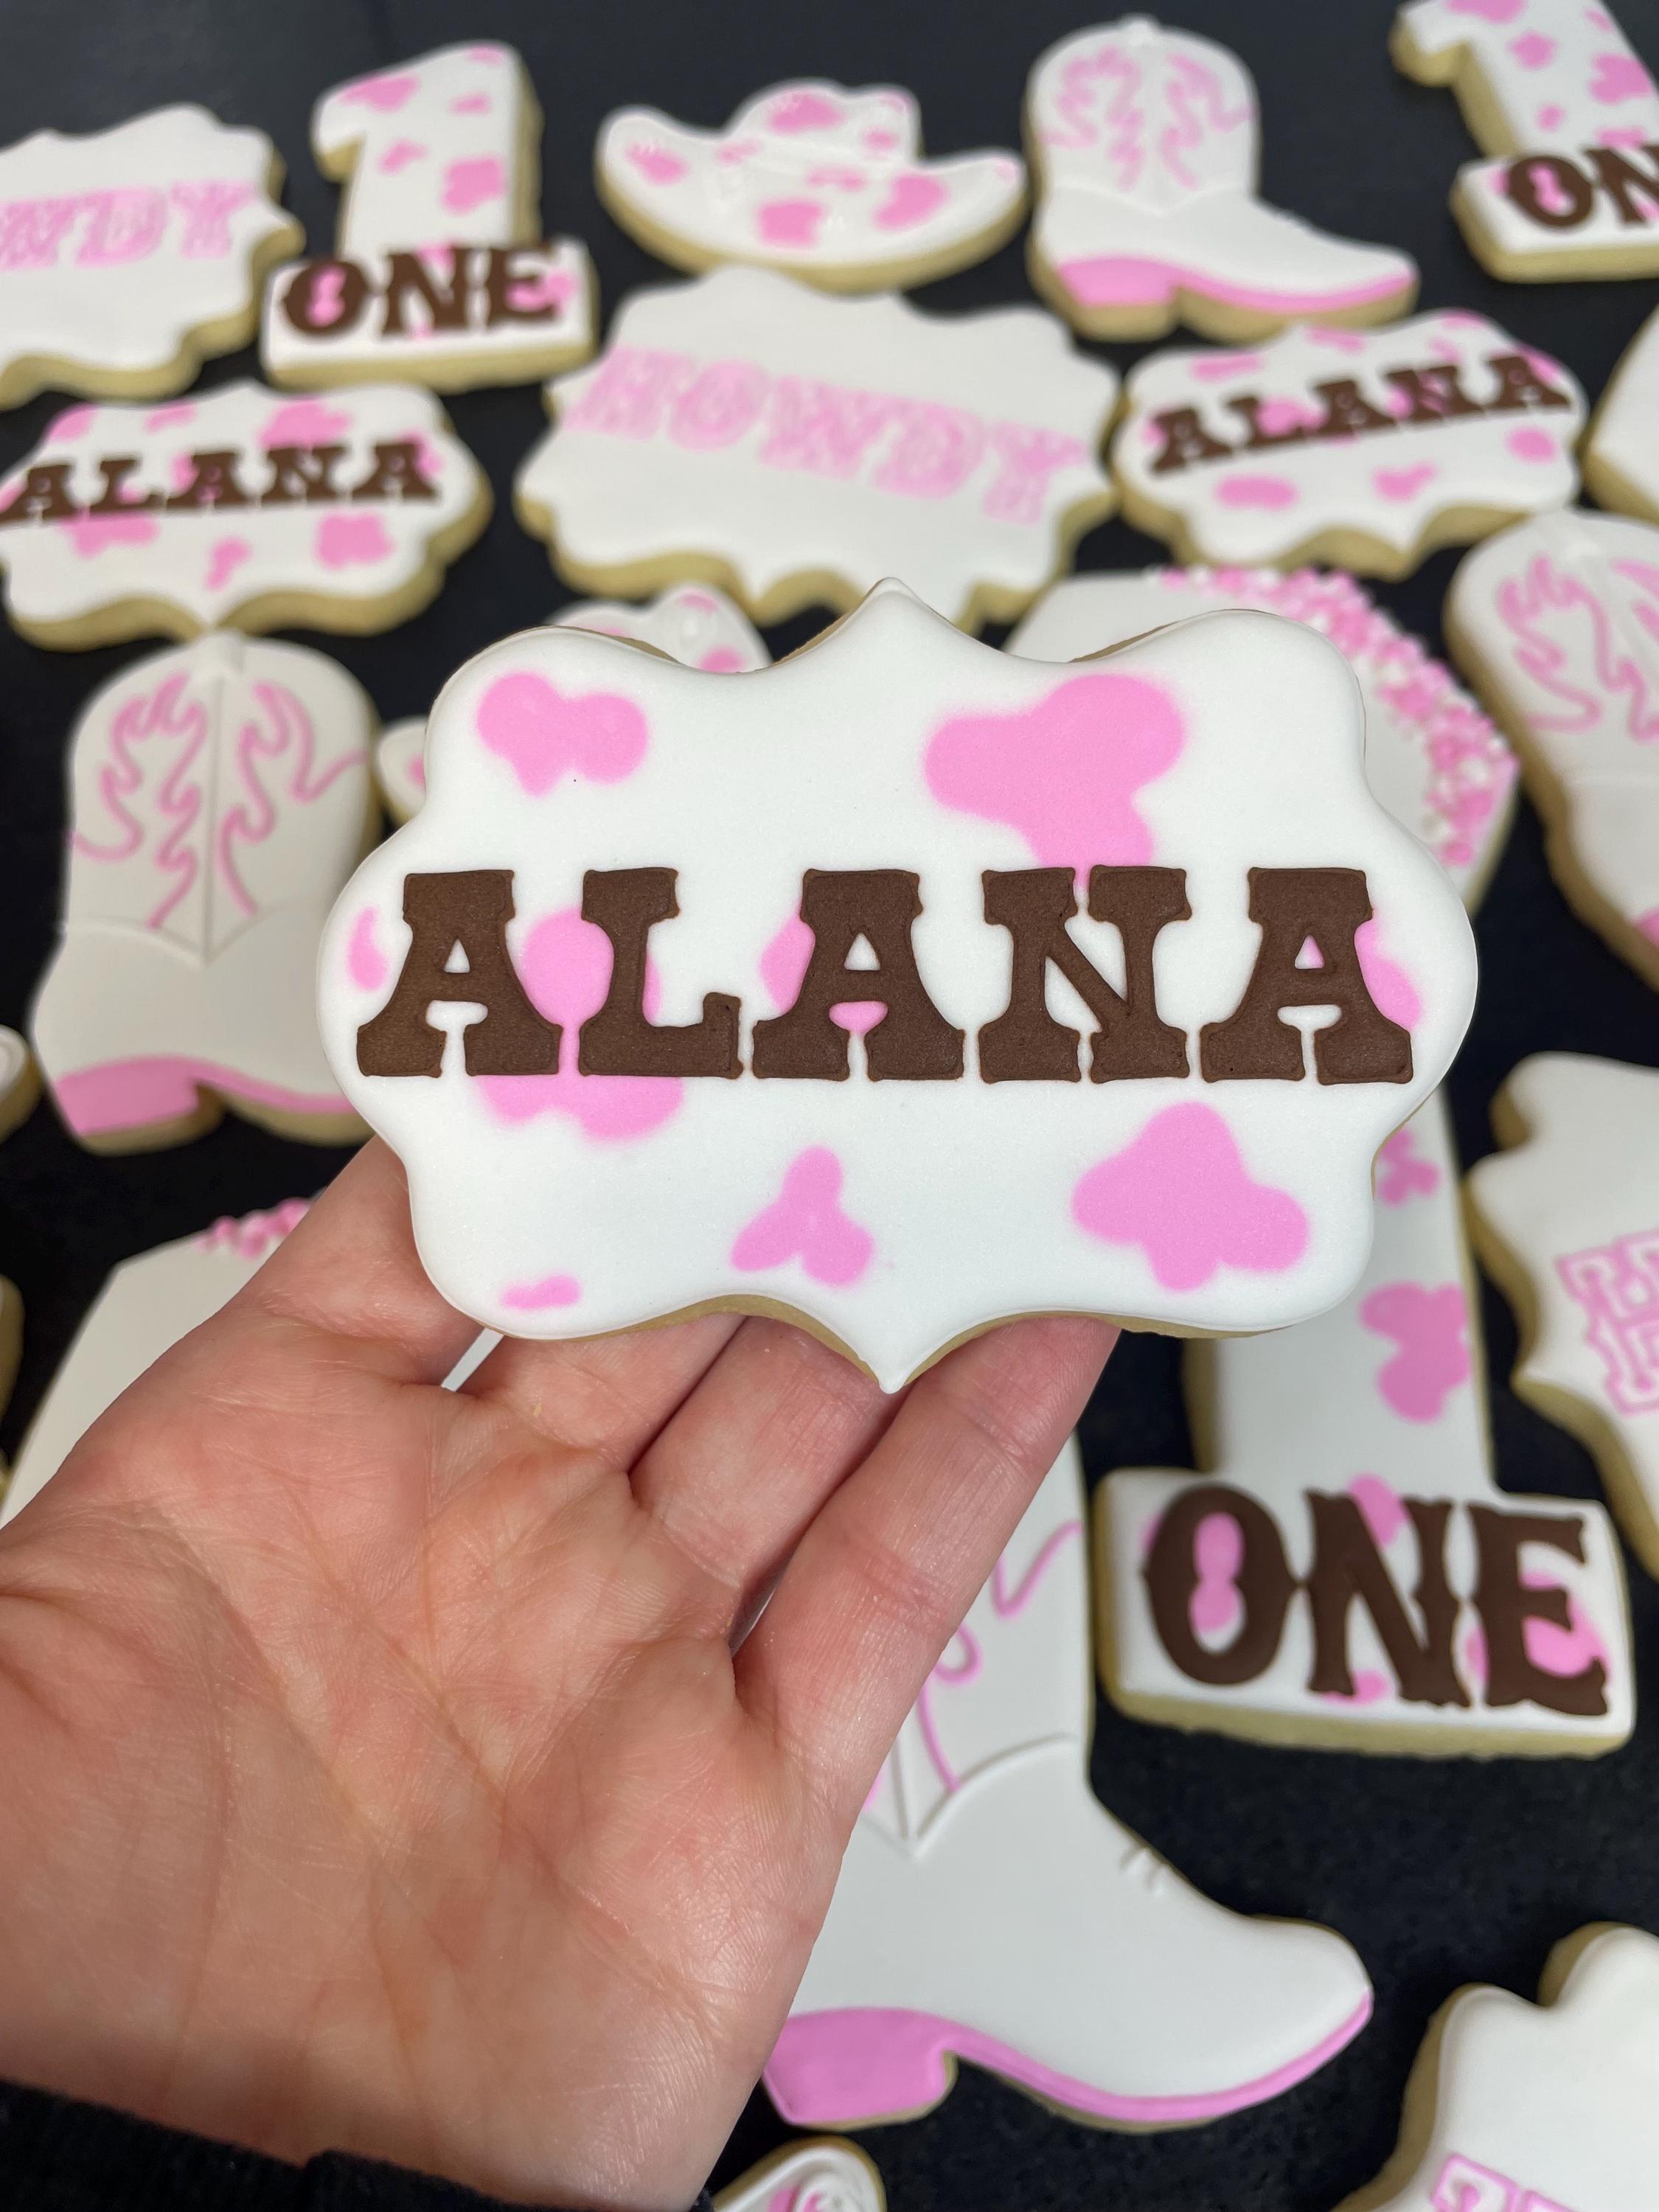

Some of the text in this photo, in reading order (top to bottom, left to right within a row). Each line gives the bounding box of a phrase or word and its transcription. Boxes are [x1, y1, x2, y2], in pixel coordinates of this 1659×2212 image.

[282, 243, 559, 341] ONE
[0, 442, 442, 528] ALANA
[563, 345, 1087, 525] HOWDY
[1150, 354, 1572, 474] ALANA
[355, 866, 1413, 1085] ALANA
[1143, 1482, 1607, 1717] ONE
